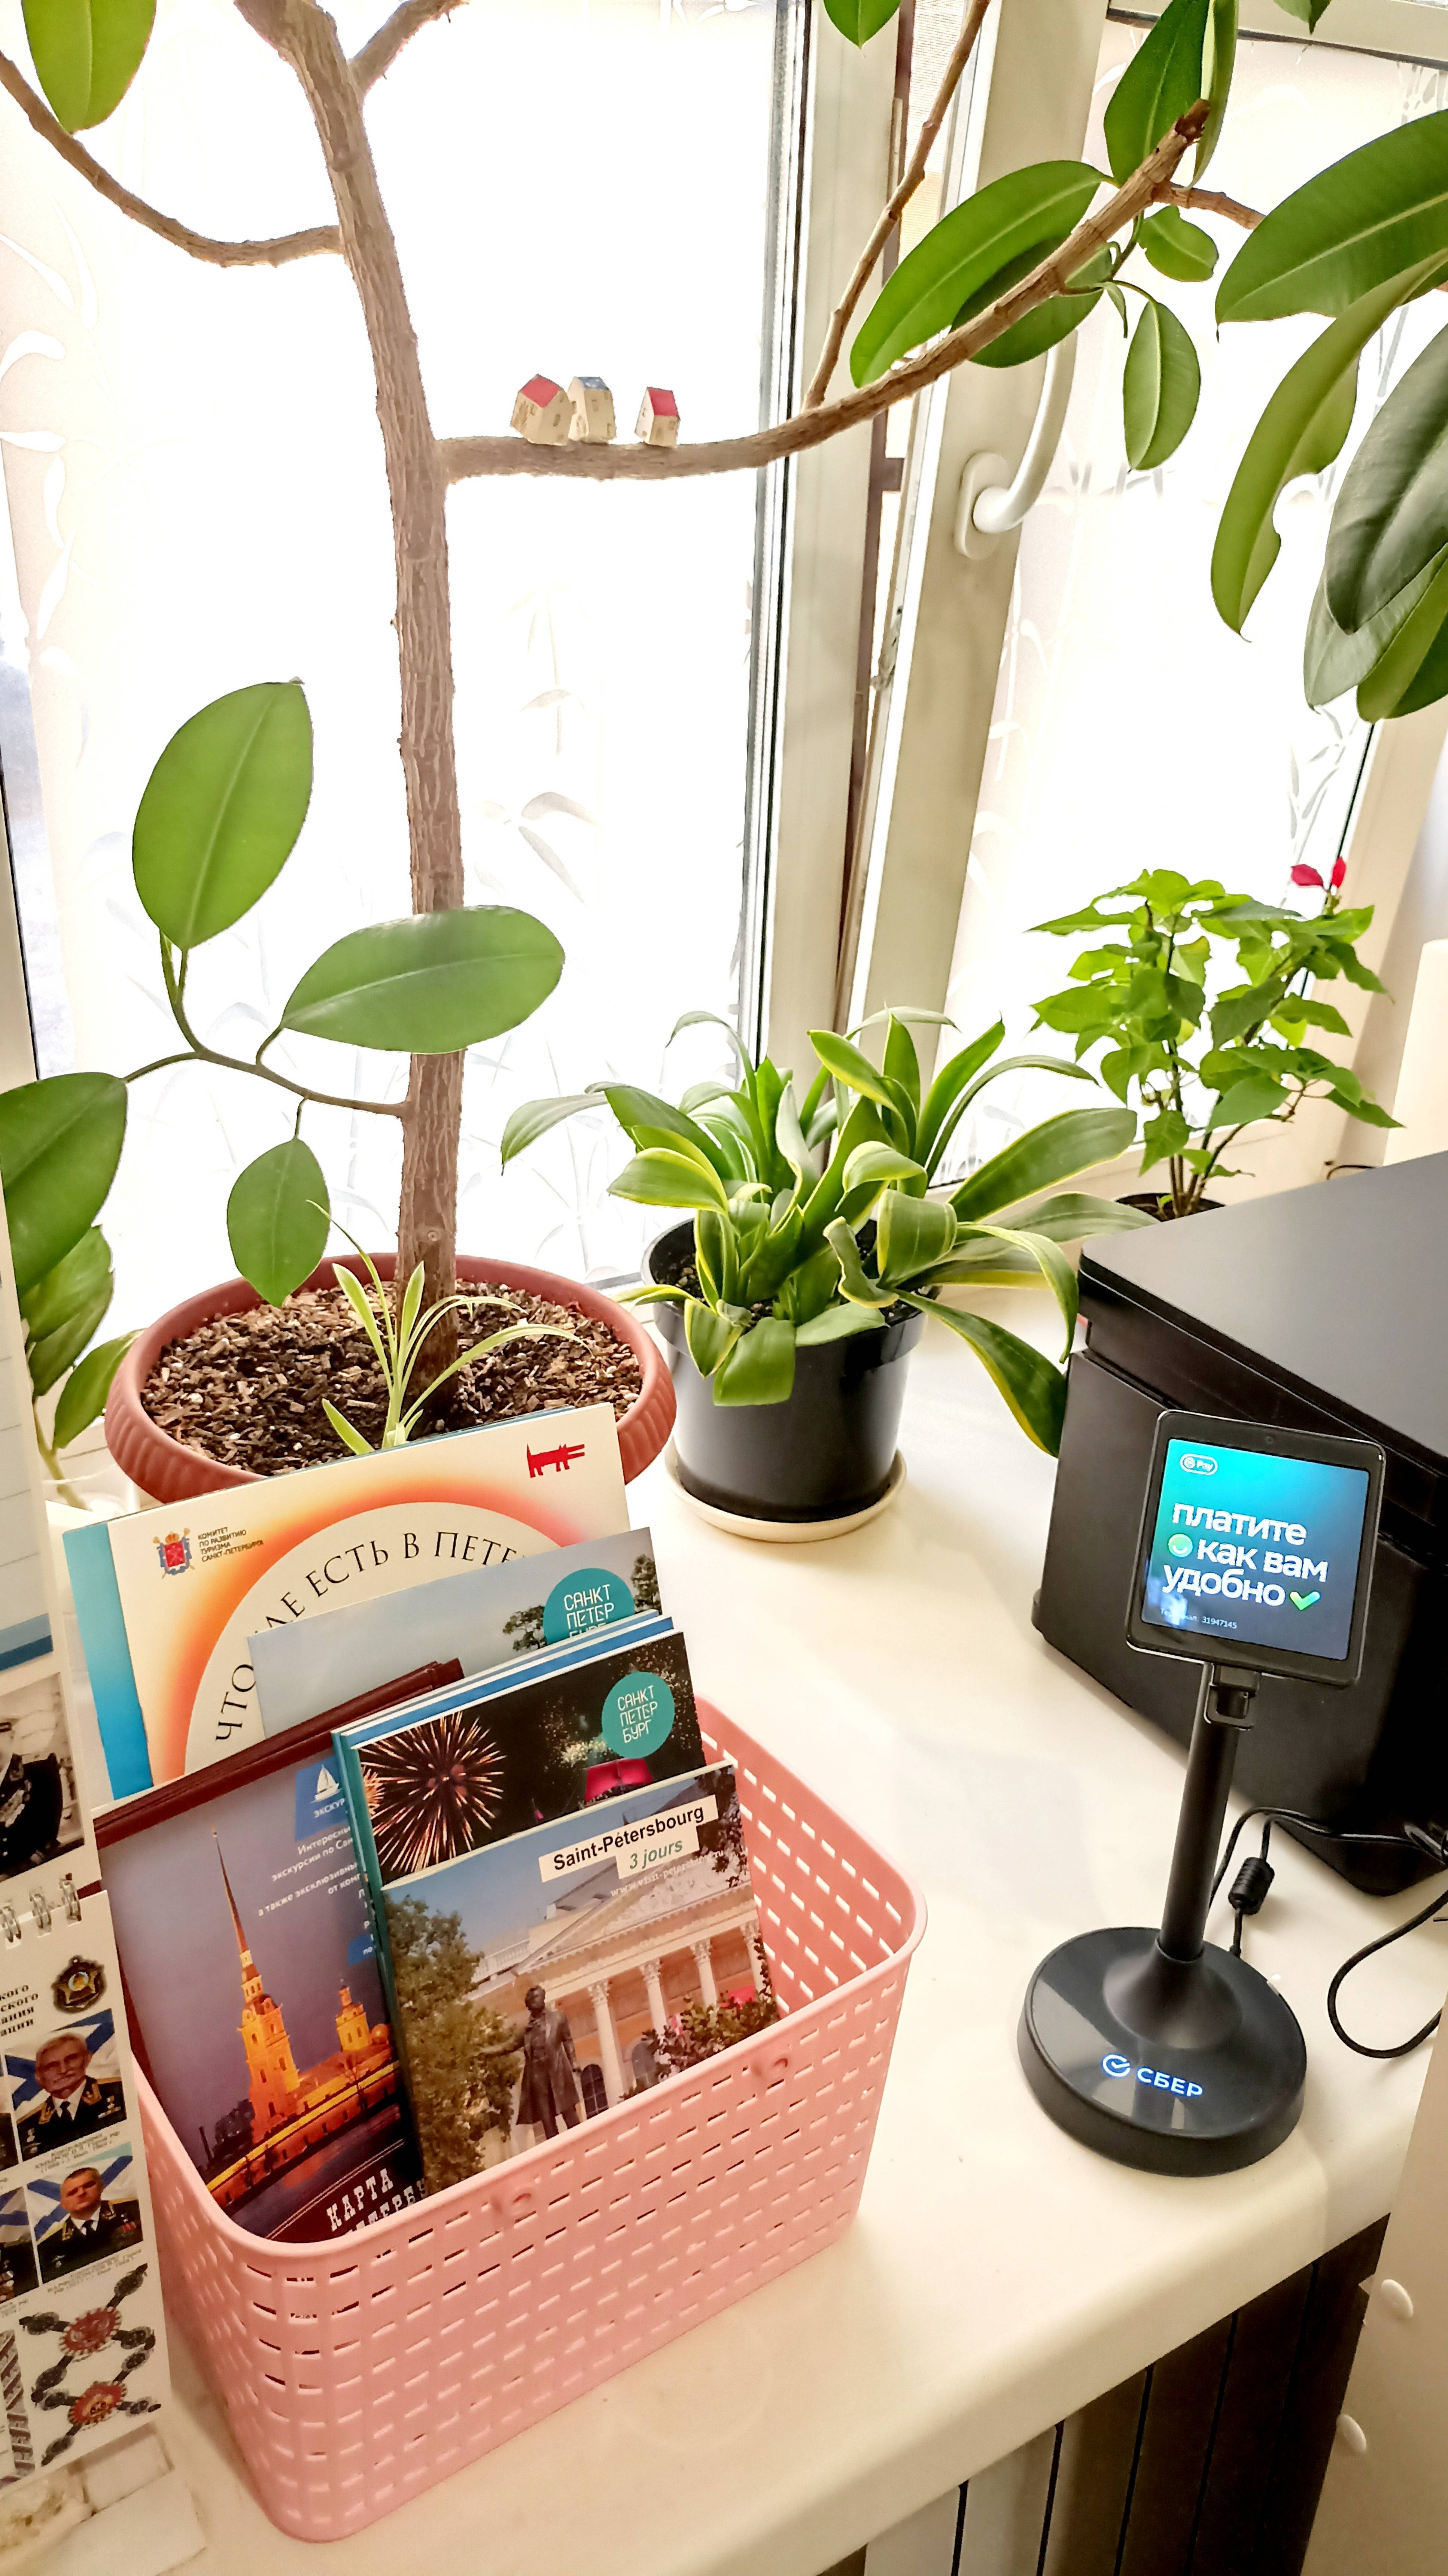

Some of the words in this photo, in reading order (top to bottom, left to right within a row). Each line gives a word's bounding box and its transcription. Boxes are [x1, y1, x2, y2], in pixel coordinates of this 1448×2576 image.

[1196, 1459, 1213, 1472] Pay
[198, 1527, 228, 1540] КОМИТЕТ
[211, 1530, 246, 1544] РАЗВИТИЮ
[1172, 1503, 1307, 1546] платите
[201, 1542, 231, 1554] ТУРИЗМА
[1197, 1539, 1258, 1570] как
[1263, 1550, 1329, 1583] вам
[564, 1584, 610, 1611] САНКТ
[1162, 1564, 1286, 1606] удобно
[566, 1603, 614, 1629] ПЕТЕР
[1202, 1616, 1237, 1629] 31947145
[215, 1664, 256, 1741] ЧТО
[305, 1540, 389, 1598] ЕСТЬ
[402, 1532, 420, 1559] В
[617, 1685, 654, 1711] САНКТ
[620, 1701, 658, 1727] ПЕТЕР
[623, 1720, 652, 1743] БУРГ
[554, 1807, 704, 1870] Saint-Pétersbourg
[271, 1854, 320, 1882] экскурсии
[322, 1847, 334, 1856] по
[630, 1853, 638, 1869] 3
[641, 1840, 683, 1869] jours
[265, 1893, 293, 1912] также
[328, 1884, 338, 1895] от
[1137, 2068, 1203, 2097] СБЕР
[326, 2168, 393, 2232] КАРТА
